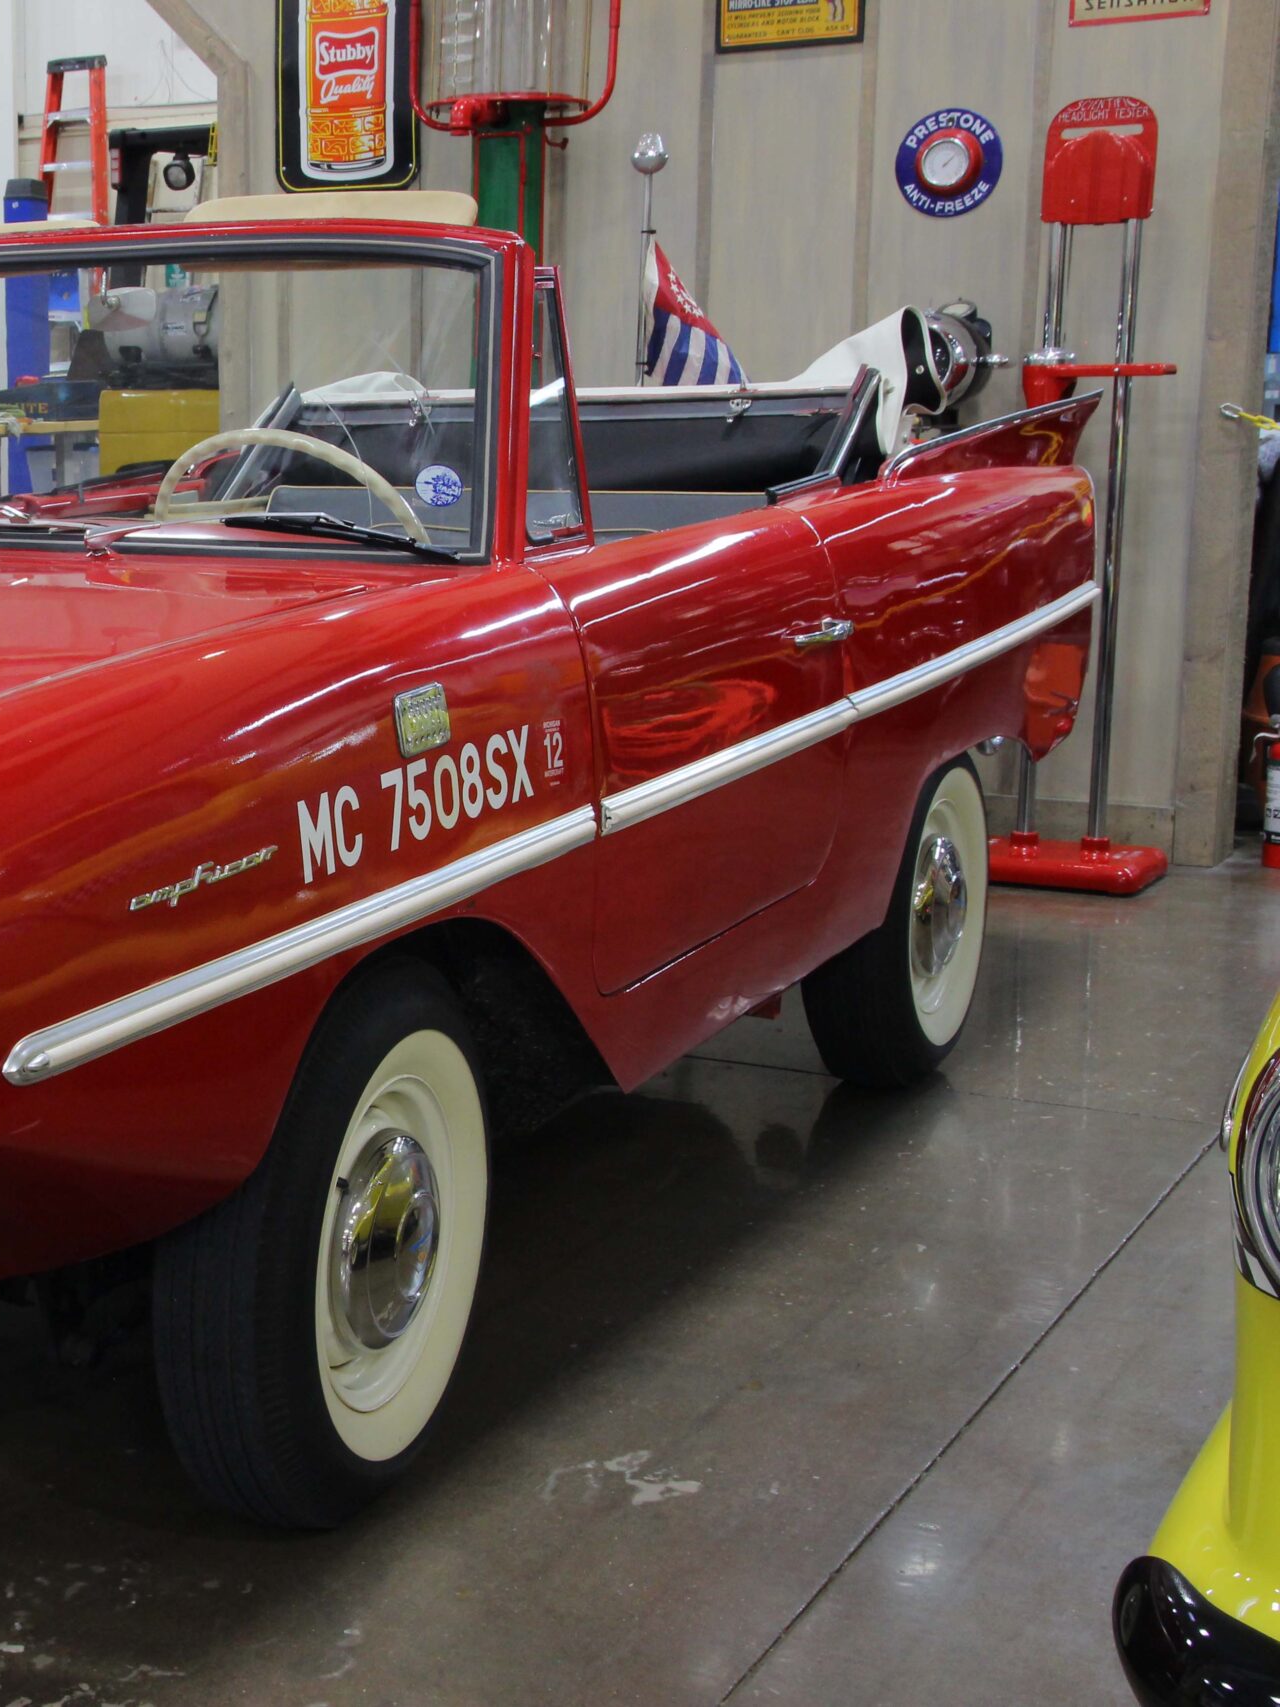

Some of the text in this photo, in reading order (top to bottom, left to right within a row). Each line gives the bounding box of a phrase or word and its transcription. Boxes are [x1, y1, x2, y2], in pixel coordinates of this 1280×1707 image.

[319, 40, 376, 66] Stubby
[319, 74, 376, 105] Quality
[905, 111, 995, 149] PRESTONE
[1058, 105, 1149, 123] HEADLIGHT TESTER
[904, 180, 990, 213] ANTI-FREEZE
[543, 731, 564, 769] 12
[296, 724, 534, 884] MC 7508SX
[129, 844, 279, 907] amphicar
